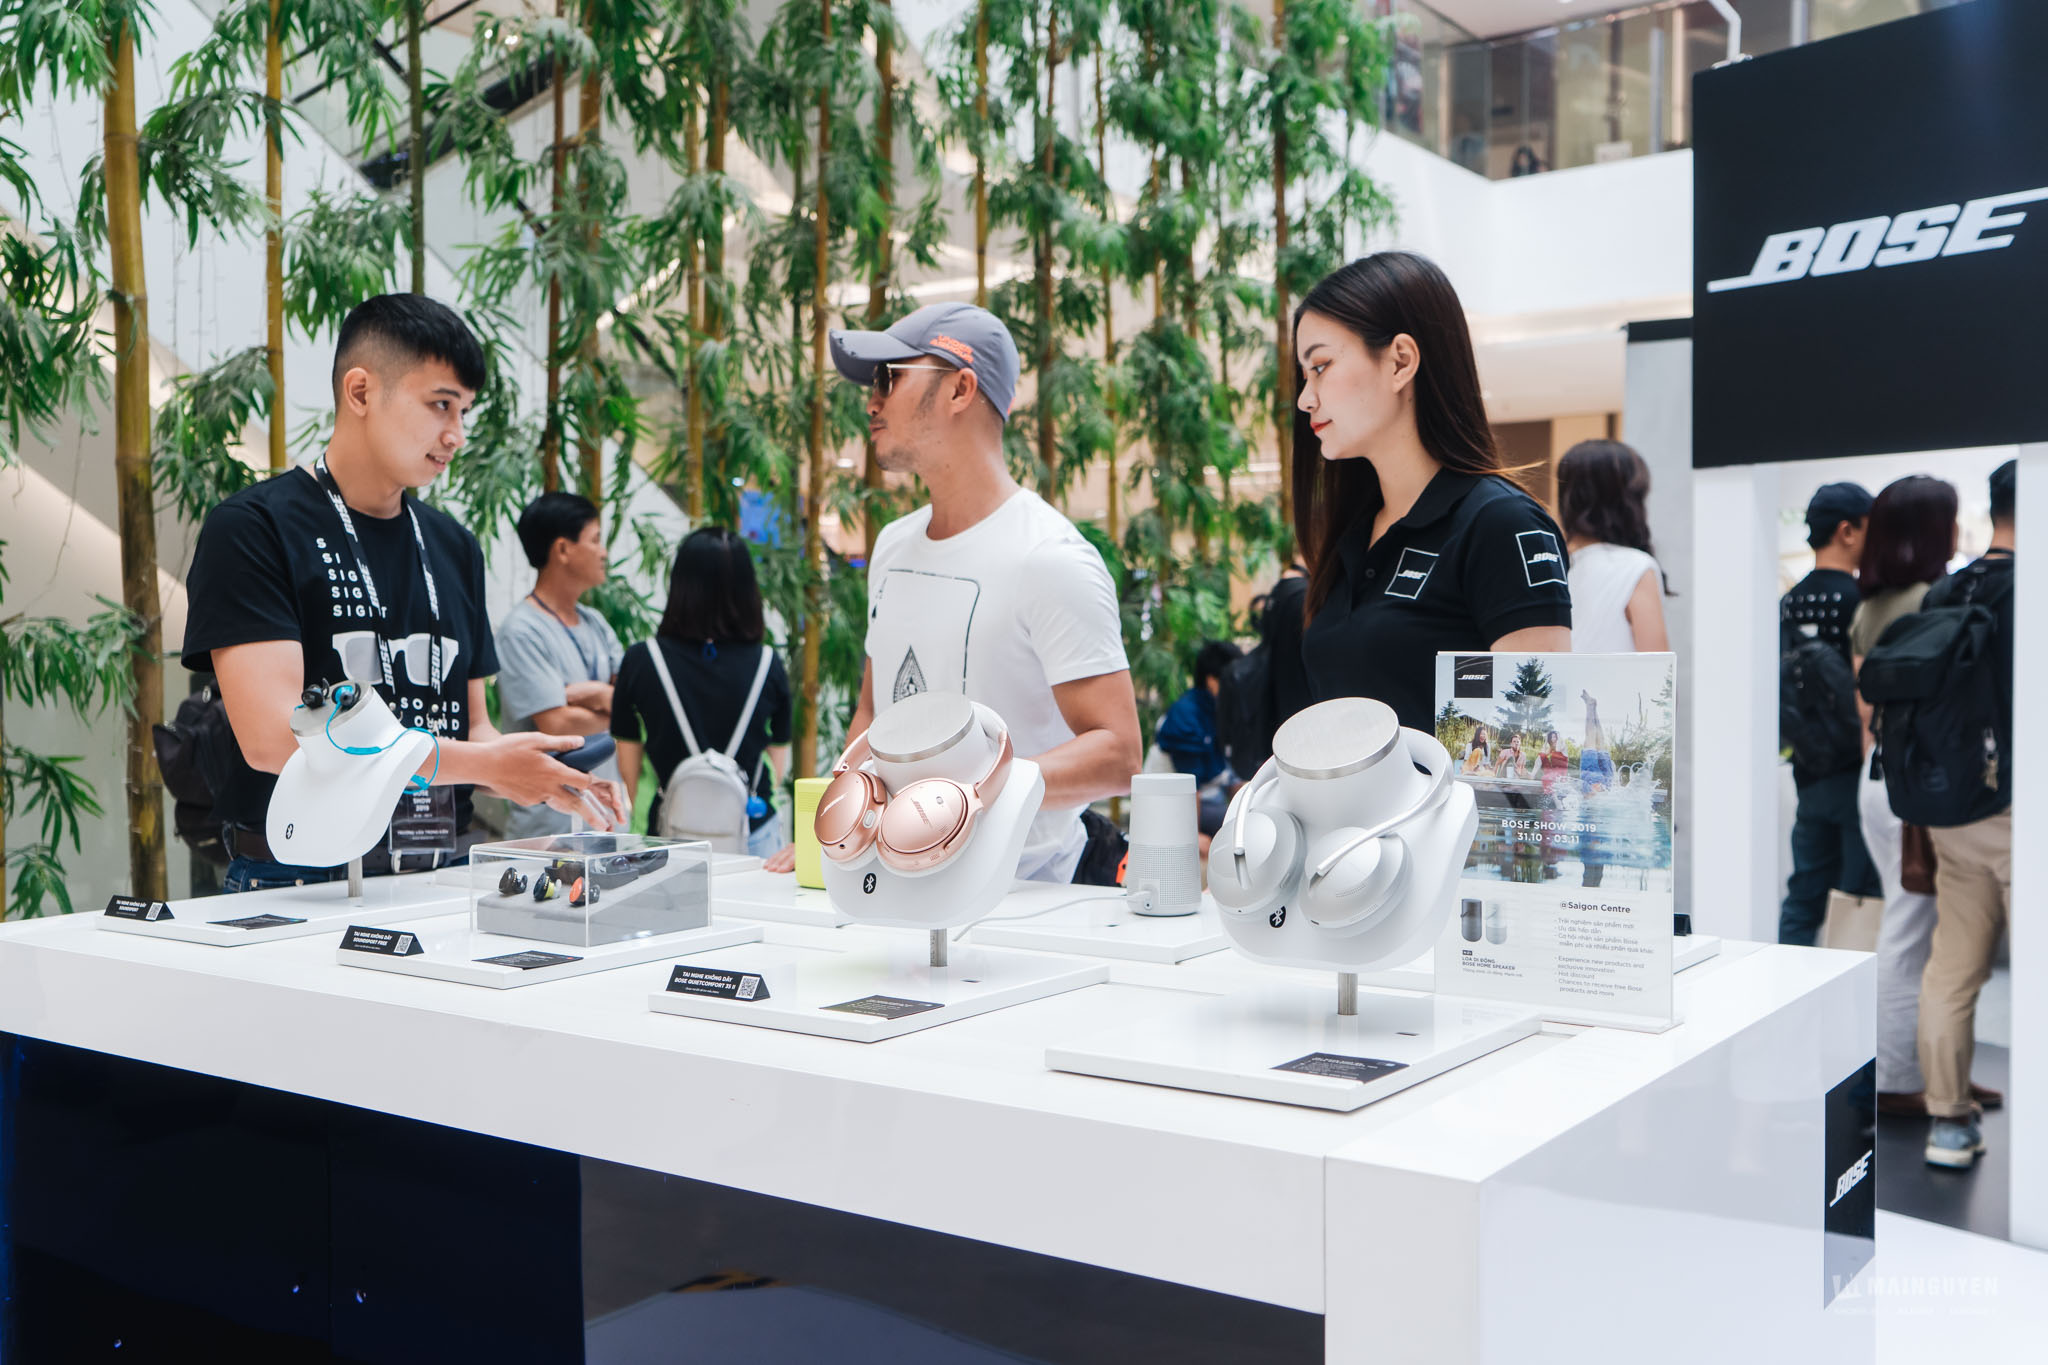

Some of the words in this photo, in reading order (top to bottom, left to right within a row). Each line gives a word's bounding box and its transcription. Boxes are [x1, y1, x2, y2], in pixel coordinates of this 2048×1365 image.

[1707, 187, 2048, 293] BOSE
[937, 334, 974, 355] UNDER
[328, 489, 358, 543] BOSE
[316, 537, 327, 548] S
[1527, 552, 1559, 563] BOSE
[356, 558, 381, 616] BOSE
[378, 633, 396, 695] BOSE
[431, 635, 441, 696] BOSE
[1502, 820, 1530, 829] BOSE
[1534, 821, 1566, 831] SHOW
[1572, 823, 1597, 833] 2019
[1517, 832, 1543, 842] 31.10
[1554, 834, 1579, 844] 03.11
[1568, 901, 1598, 911] Saigon
[1600, 904, 1631, 913] Centre
[1558, 956, 1590, 964] Experience
[1605, 960, 1631, 968] products
[688, 978, 725, 988] QUIETCOMFORT
[690, 972, 705, 980] NGHE
[704, 973, 722, 981] KHÔNG
[722, 975, 733, 983] DÂY
[1829, 1150, 1873, 1208] BOSE
